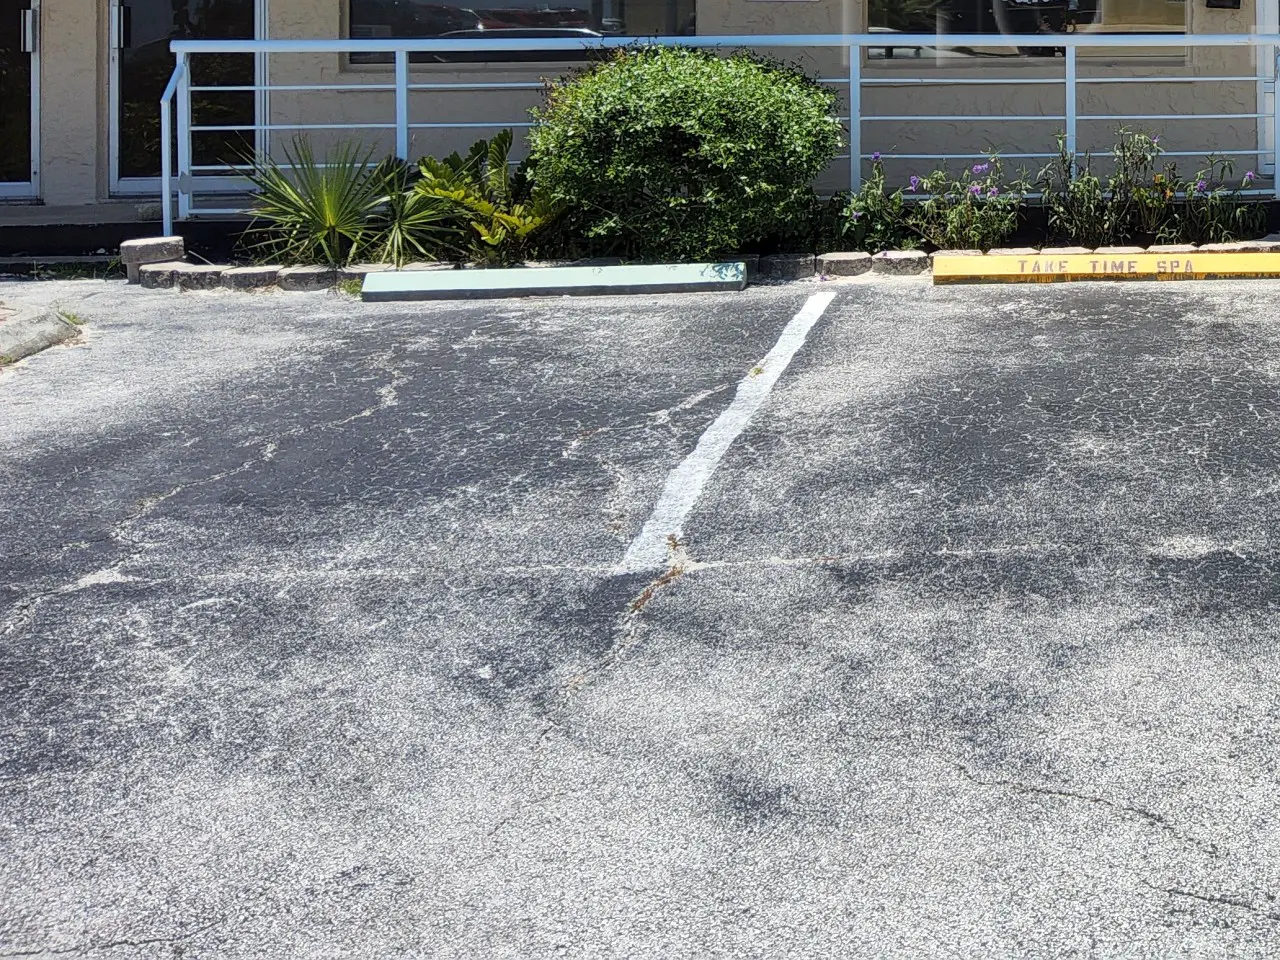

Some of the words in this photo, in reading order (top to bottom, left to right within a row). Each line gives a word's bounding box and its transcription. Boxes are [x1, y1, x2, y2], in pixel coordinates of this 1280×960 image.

[1017, 259, 1069, 275] TAKE
[1088, 259, 1139, 275] TIME
[1156, 259, 1194, 275] SPA
